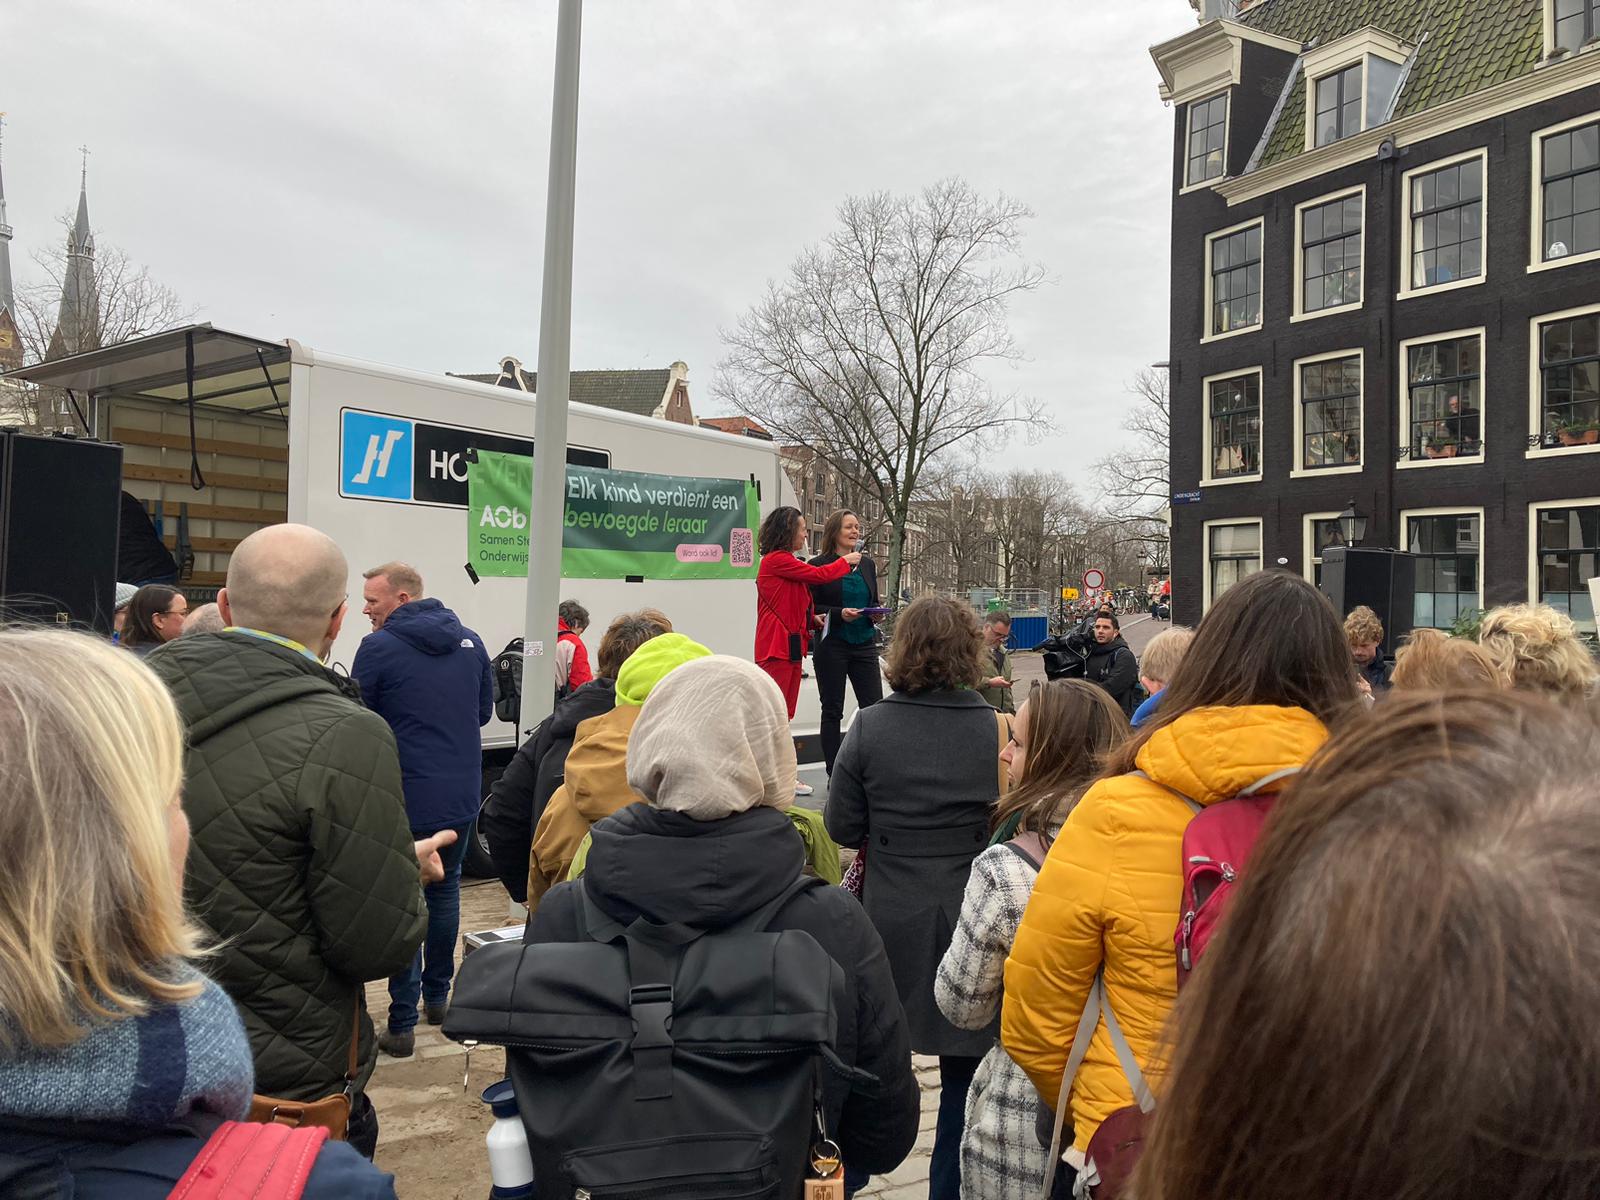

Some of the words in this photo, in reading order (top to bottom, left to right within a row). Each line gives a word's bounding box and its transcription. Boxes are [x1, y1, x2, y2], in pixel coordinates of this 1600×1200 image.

[567, 475, 598, 500] Elk
[600, 478, 642, 504] kind
[644, 484, 711, 508] verdient
[711, 494, 739, 511] een
[479, 504, 527, 529] AOb
[564, 503, 660, 538] bevoegde
[662, 510, 709, 534] leraar
[480, 533, 515, 545] Samen
